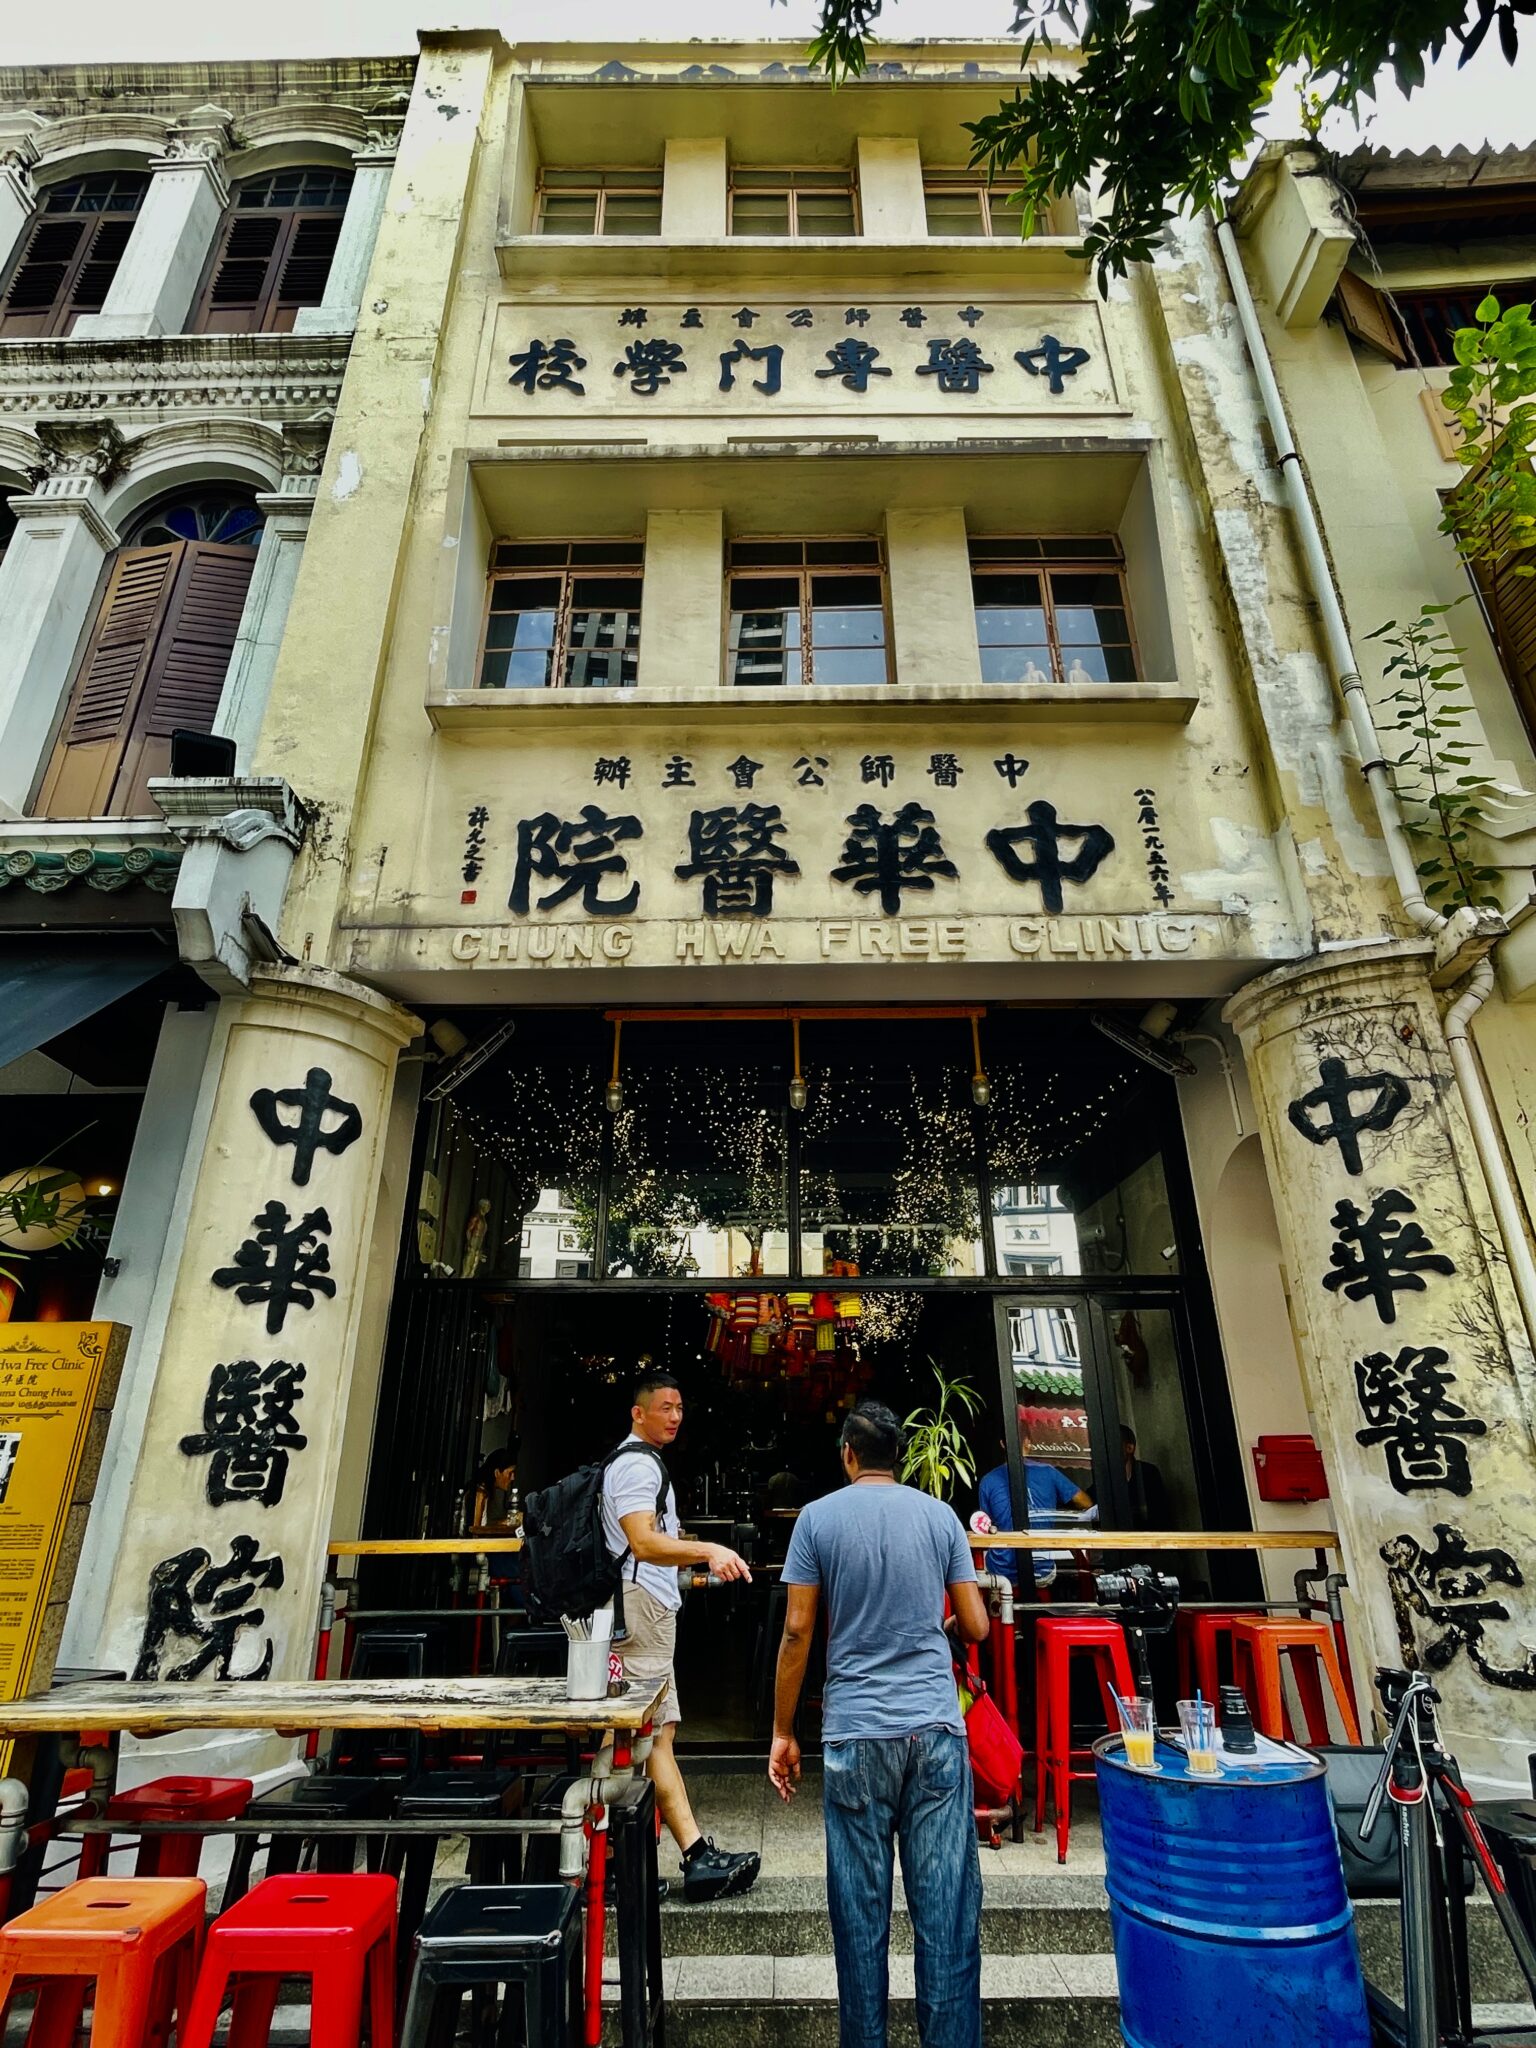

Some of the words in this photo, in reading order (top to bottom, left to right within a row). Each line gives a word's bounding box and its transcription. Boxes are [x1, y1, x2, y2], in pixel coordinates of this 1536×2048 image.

[507, 799, 1115, 918] 中華醫院
[450, 924, 634, 961] CHUNG
[675, 922, 786, 958] HWA
[820, 919, 967, 956] FREE
[1008, 918, 1196, 954] CLINIC
[25, 1359, 49, 1371] Free
[52, 1358, 86, 1371] Clinic
[133, 1066, 363, 1682] 中華醫院
[19, 1388, 49, 1400] Chung
[51, 1388, 73, 1397] Hwa
